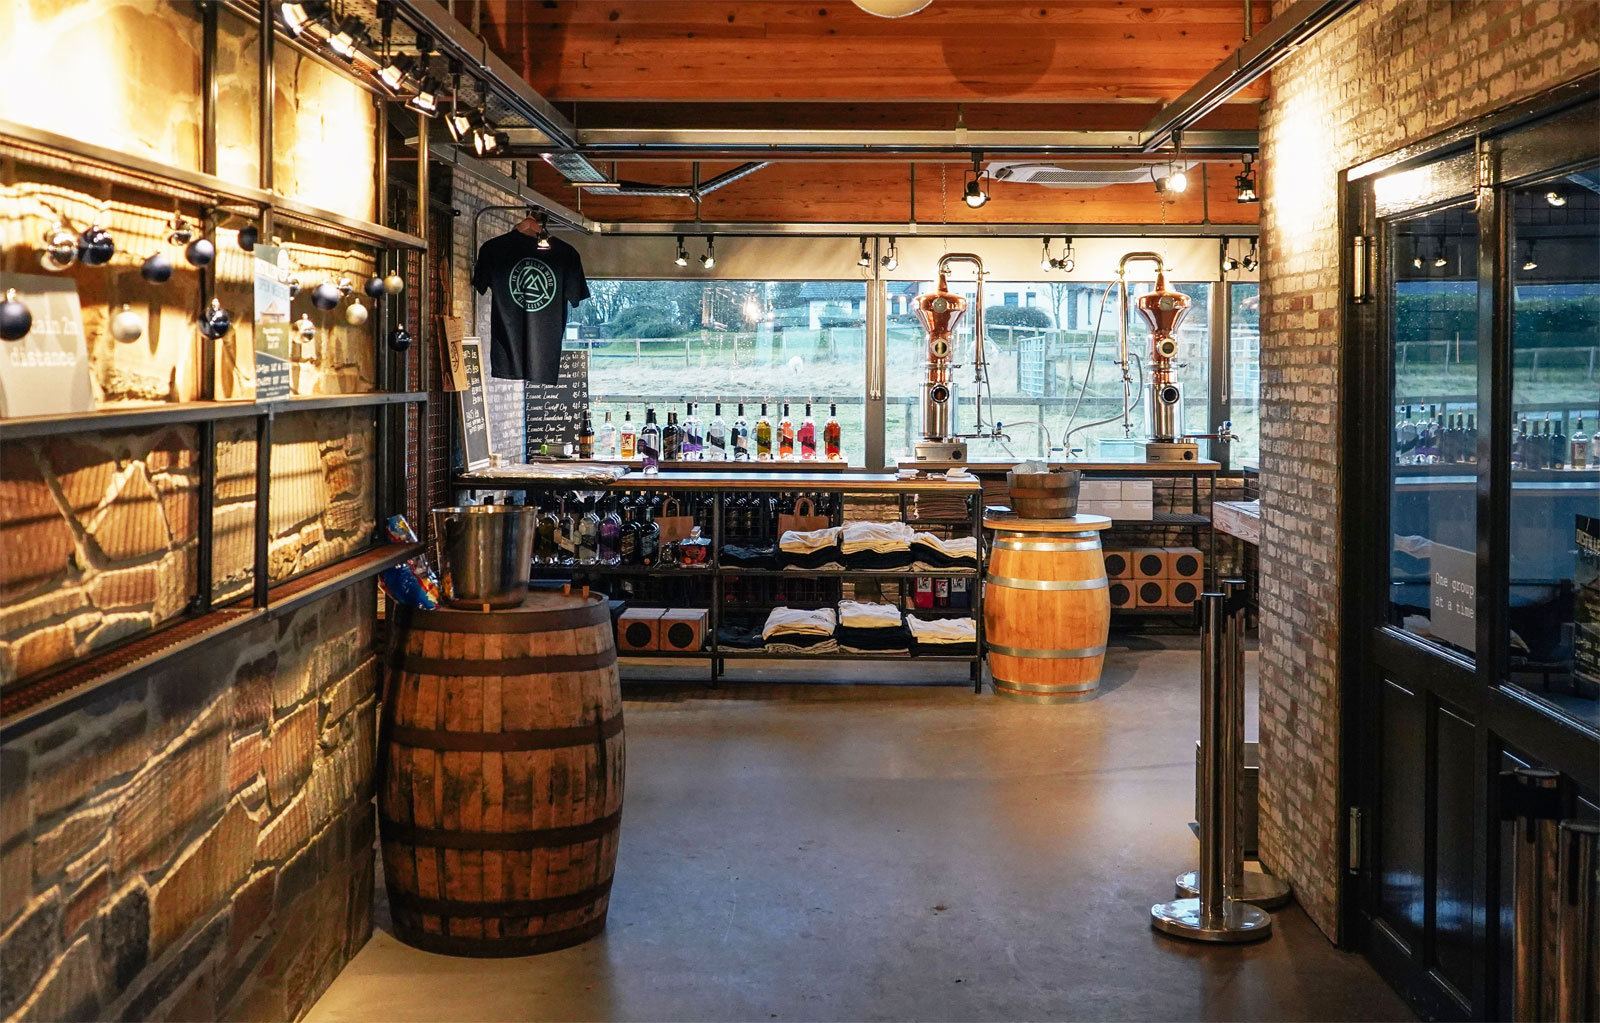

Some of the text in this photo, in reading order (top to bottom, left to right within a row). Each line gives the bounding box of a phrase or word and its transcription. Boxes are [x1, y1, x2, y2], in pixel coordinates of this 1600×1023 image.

[545, 270, 554, 287] WIND
[1435, 572, 1474, 599] One group
[1434, 596, 1474, 619] at a time
